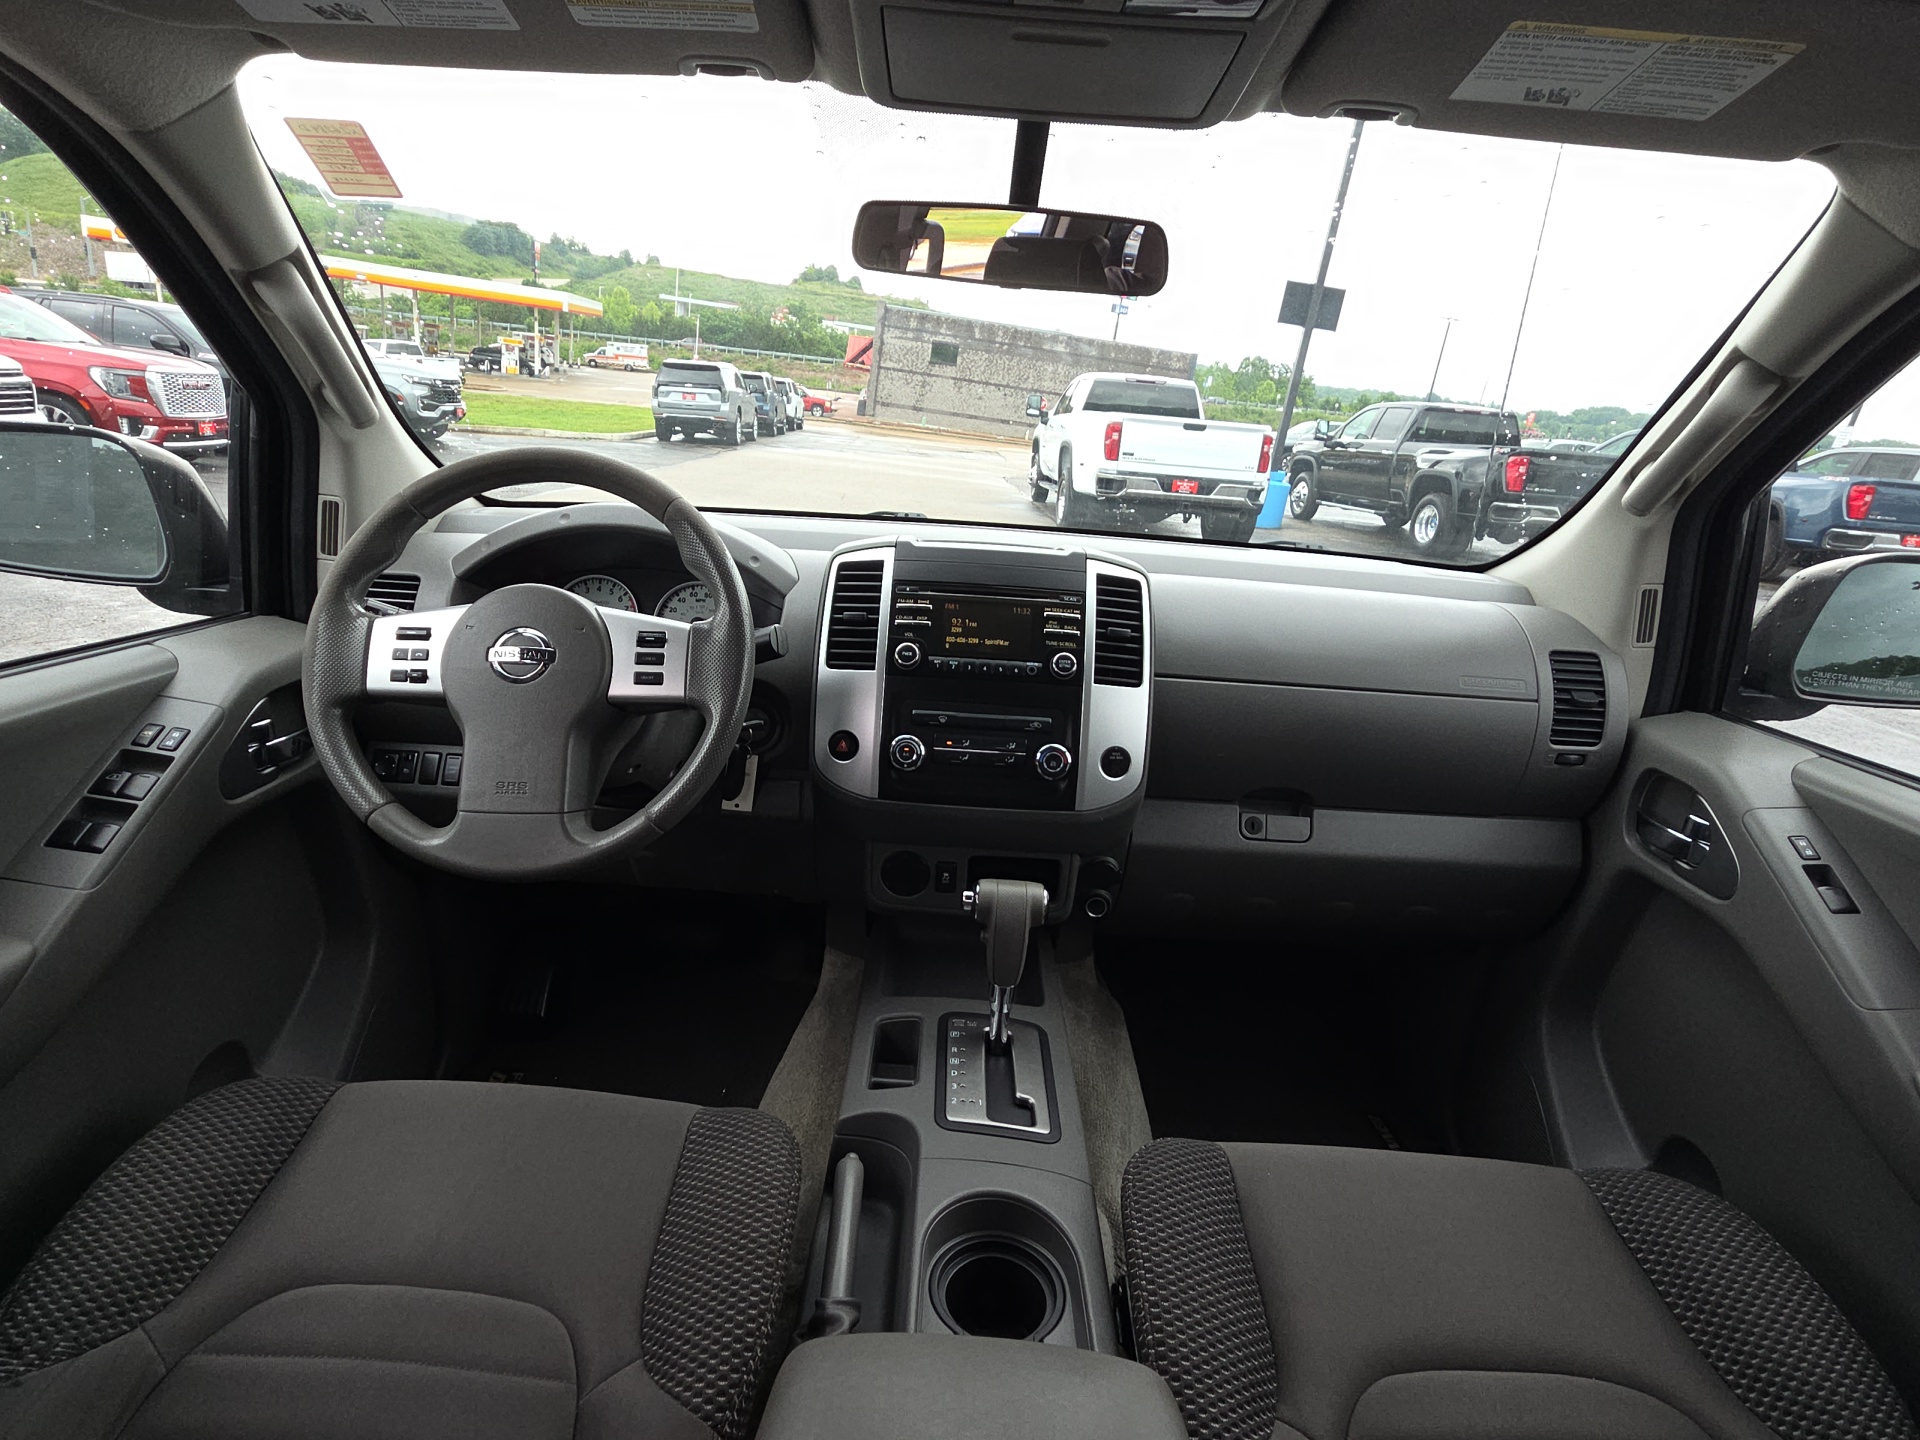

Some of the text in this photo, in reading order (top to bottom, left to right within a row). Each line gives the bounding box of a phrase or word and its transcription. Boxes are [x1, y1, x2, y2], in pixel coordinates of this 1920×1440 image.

[1533, 24, 1588, 34] WARNING
[1013, 606, 1031, 615] 11:32
[493, 650, 549, 660] NISSAN
[1812, 671, 1848, 680] OBJECTS
[1860, 677, 1894, 686] MIRROR
[1803, 677, 1836, 685] CLOSER
[1884, 687, 1920, 696] APPEAR
[495, 781, 528, 789] SRS
